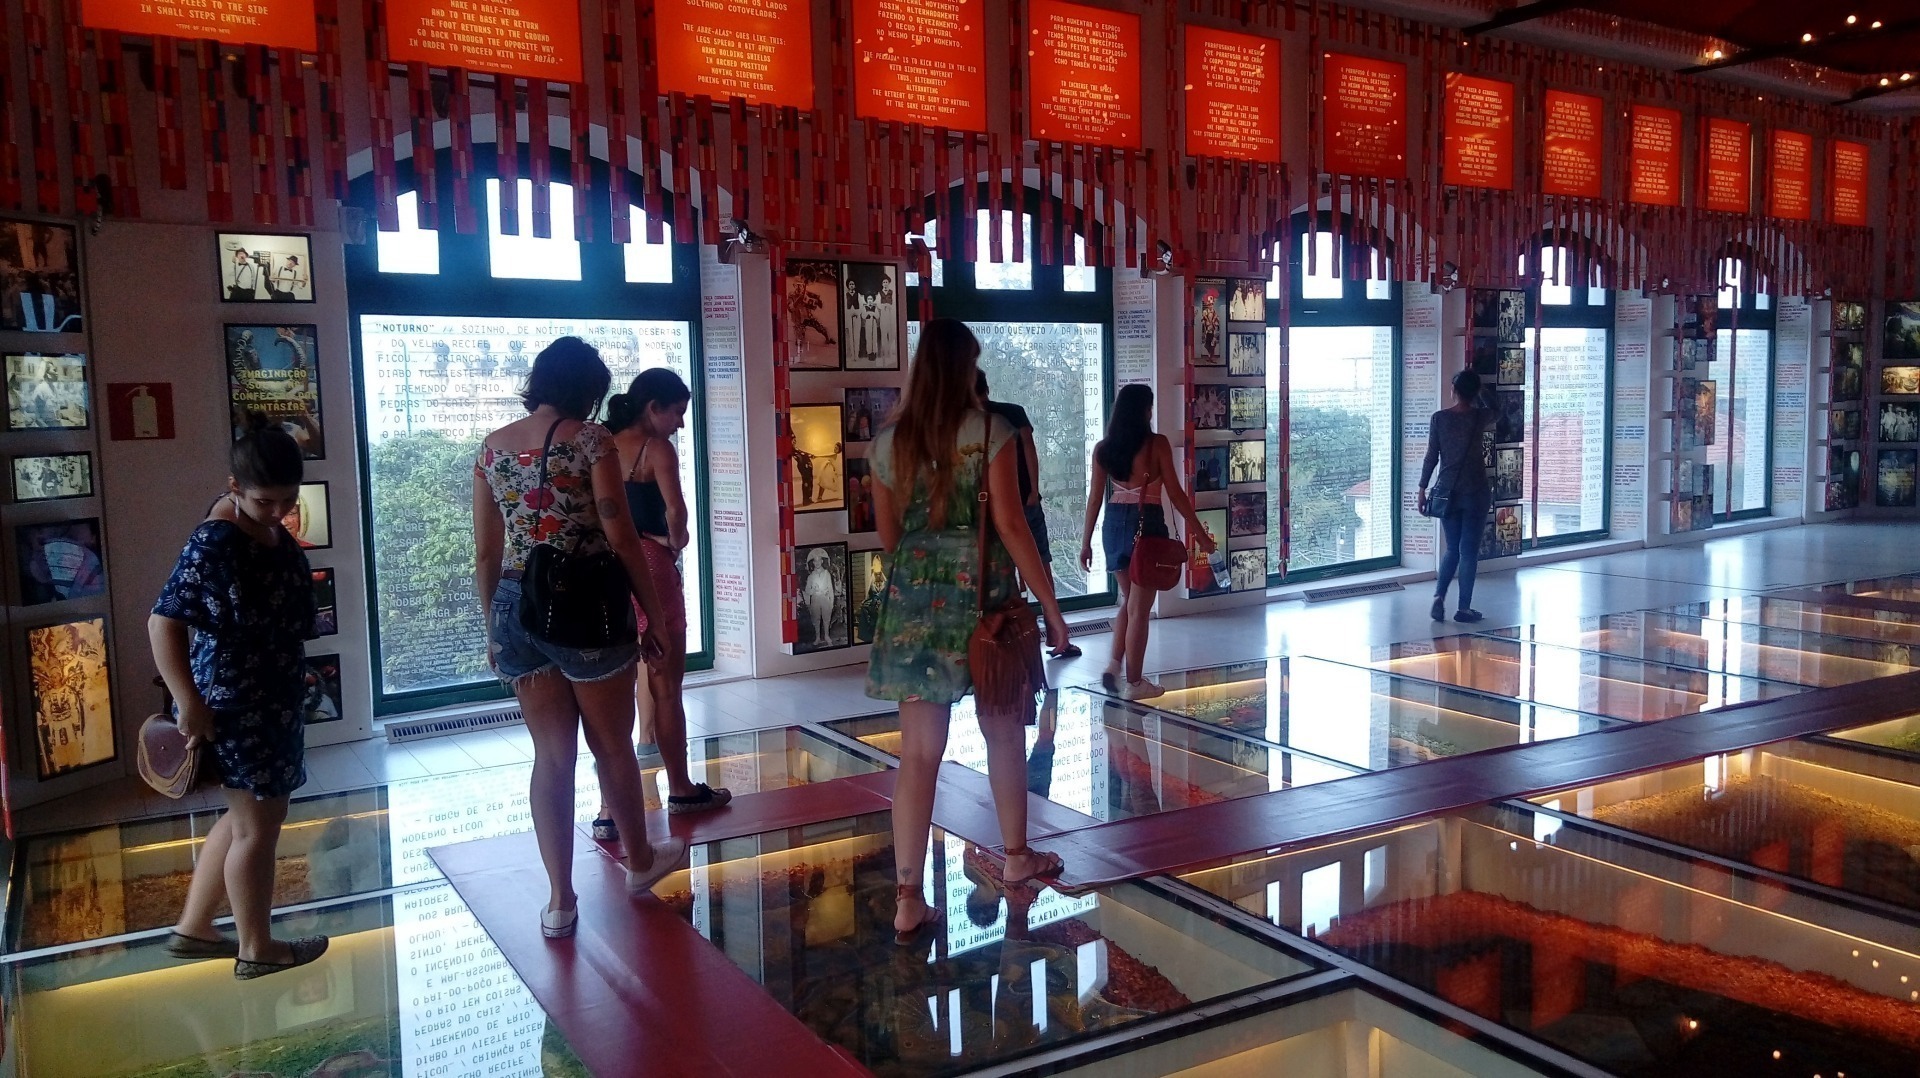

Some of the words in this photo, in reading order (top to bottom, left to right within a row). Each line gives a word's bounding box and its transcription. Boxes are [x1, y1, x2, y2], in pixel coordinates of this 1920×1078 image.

[451, 0, 469, 10] MAKE
[481, 4, 520, 16] HALF-TURN
[432, 8, 446, 18] AND
[449, 11, 459, 19] TO
[462, 13, 476, 22] THE
[479, 15, 497, 24] BASE
[500, 18, 510, 26] WE
[513, 19, 539, 30] RETURN
[421, 18, 435, 27] THE
[438, 20, 457, 30] FOOT
[461, 23, 492, 34] RETURNS
[495, 27, 505, 36] TO
[508, 29, 521, 38] THE
[524, 31, 549, 41] GROUND
[417, 29, 427, 37] GO
[430, 30, 450, 40] BACK
[453, 33, 484, 44] THROUGH
[488, 38, 501, 46] THE
[504, 40, 538, 51] OPPOSITE
[541, 45, 554, 53] WAY
[409, 38, 419, 47] IN
[422, 40, 445, 50] ORDER
[449, 43, 459, 52] TO
[462, 45, 493, 56] PROCEED
[496, 49, 515, 58] WITH
[518, 52, 531, 60] THE
[376, 324, 434, 332] "NOTURNO"
[518, 326, 529, 334] DE
[639, 328, 681, 336] DESERTAS
[1008, 327, 1022, 335] QUE
[1074, 327, 1097, 336] MINHA
[392, 339, 405, 347] DO
[452, 340, 489, 348] RECIFE
[645, 342, 681, 350] MODERNO
[437, 355, 480, 365] CRIANÇA
[666, 356, 682, 364] QUE
[243, 368, 307, 379] IMAGINAÇÃO
[379, 370, 411, 378] DIABO
[419, 370, 430, 378] TU
[438, 370, 474, 378] VIESTE
[482, 370, 511, 378] FAZER
[395, 385, 446, 393] TREMENDO
[380, 400, 420, 408] PEDRAS
[407, 415, 426, 423] RIO
[1085, 418, 1099, 426] QUE
